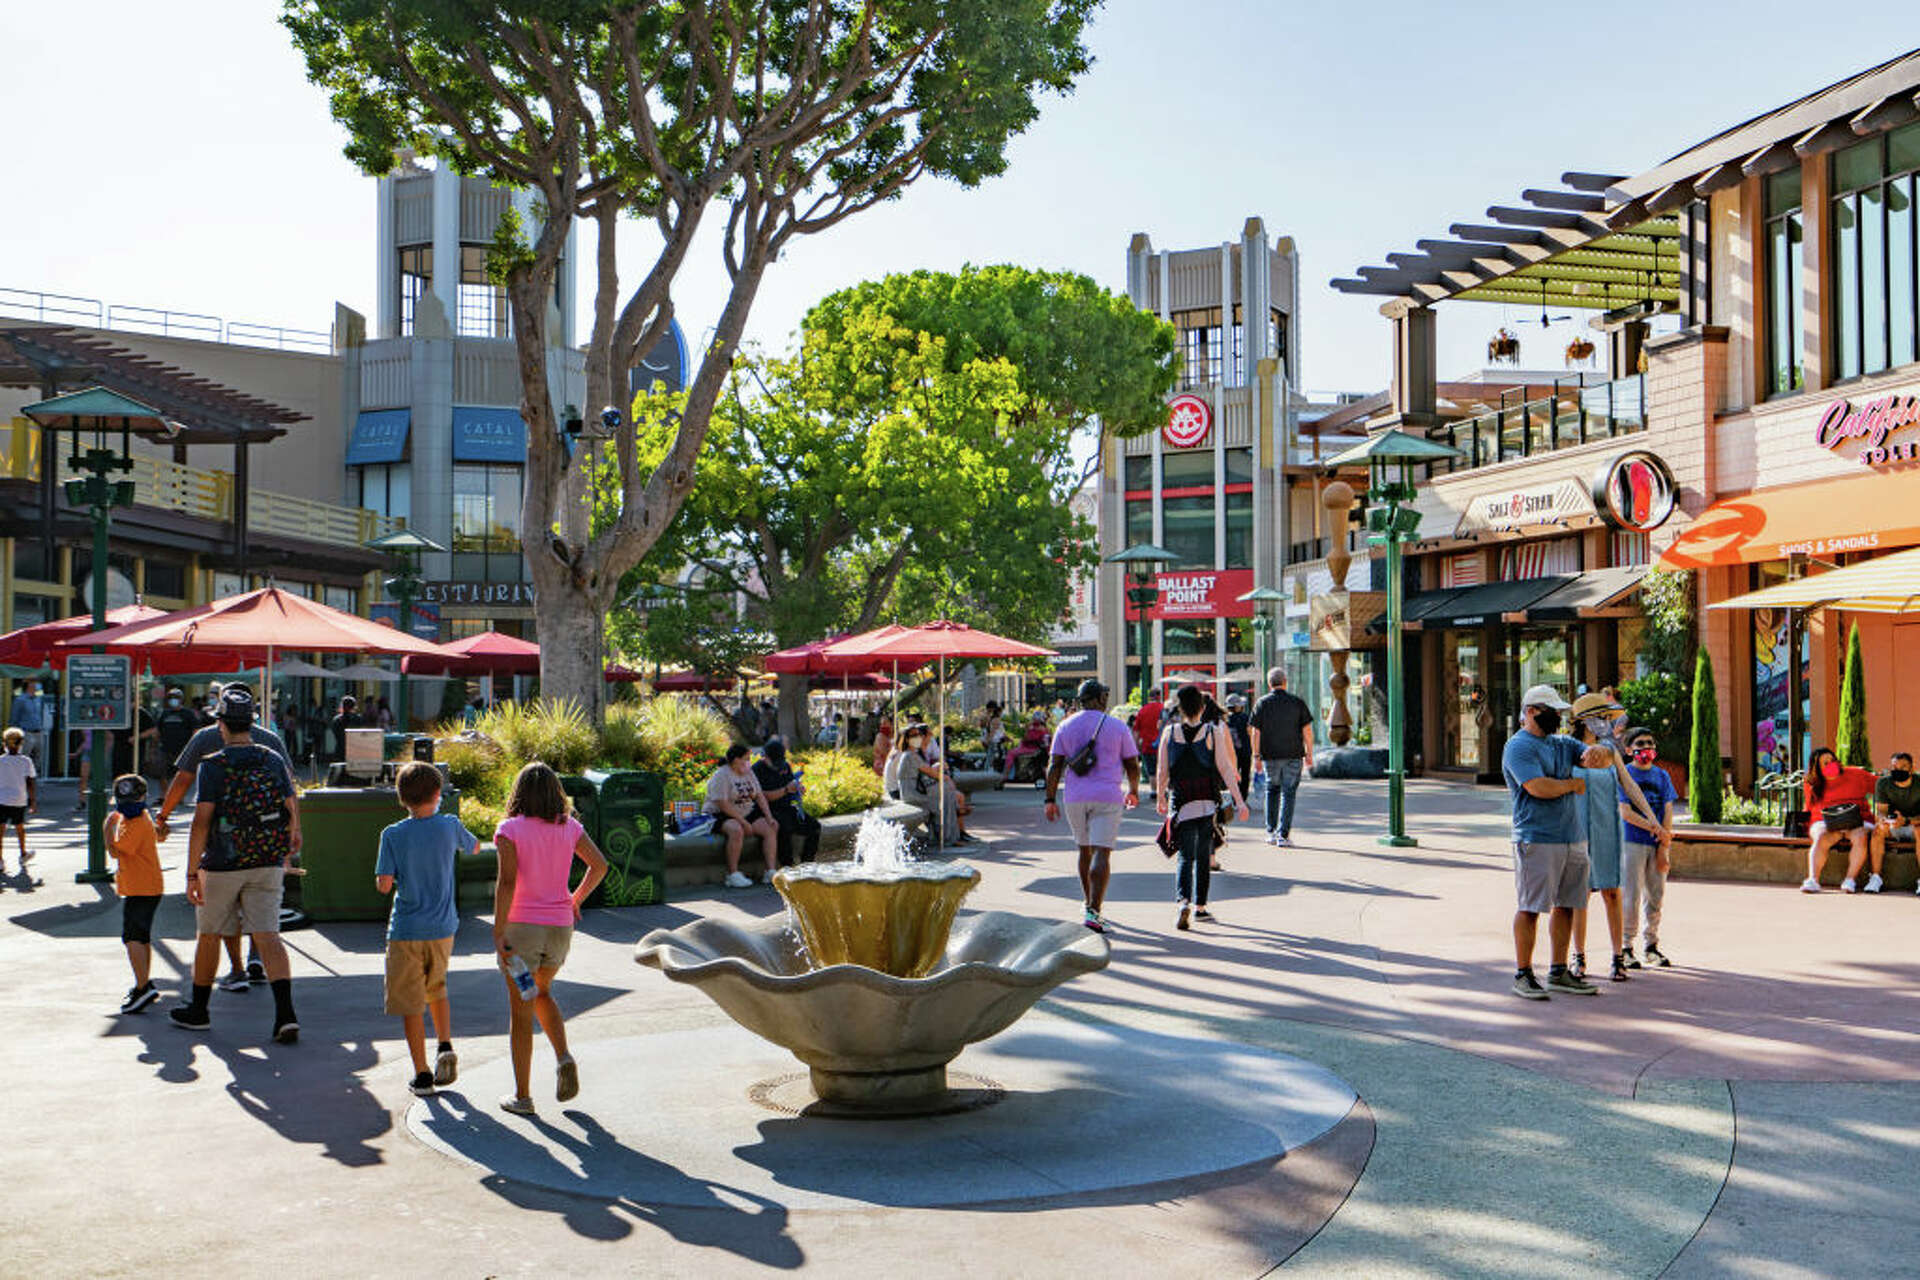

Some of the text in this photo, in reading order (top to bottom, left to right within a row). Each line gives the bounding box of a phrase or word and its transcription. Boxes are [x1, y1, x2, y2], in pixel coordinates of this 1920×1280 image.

[1828, 534, 1879, 552] SANDALS
[1158, 576, 1216, 592] BALLAST
[424, 584, 535, 603] ESTAURAN
[1167, 589, 1209, 603] POINT
